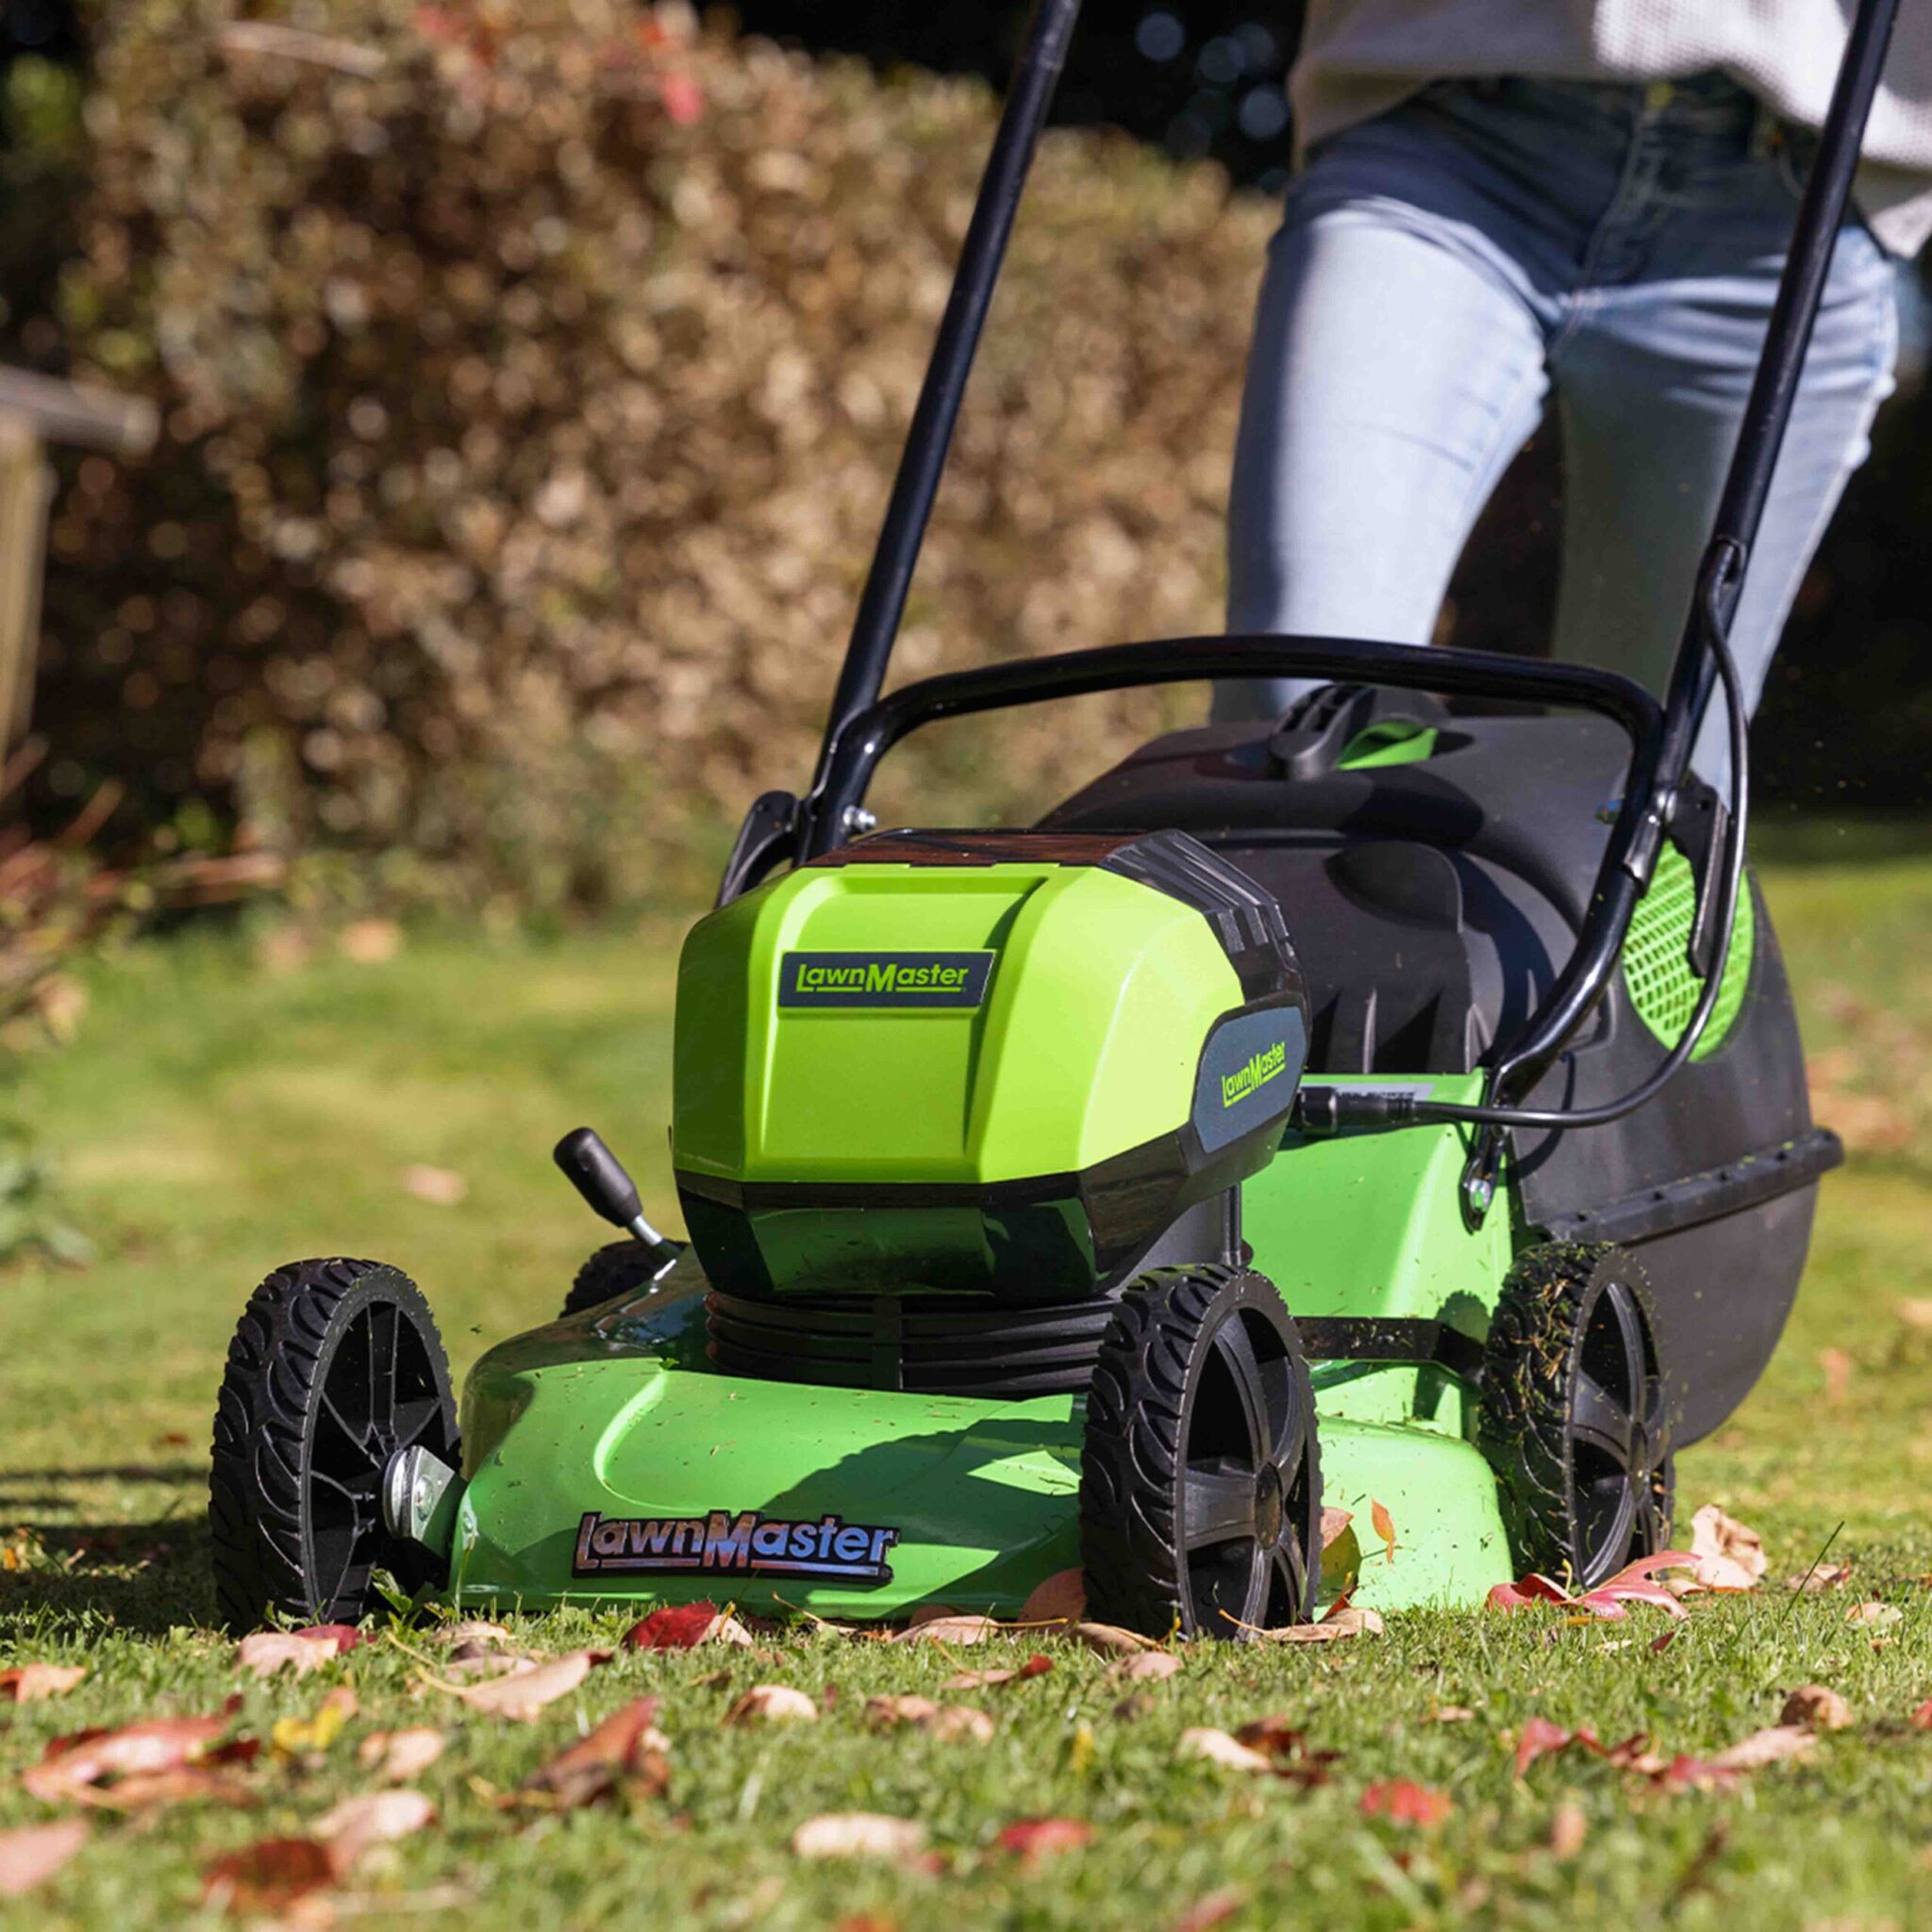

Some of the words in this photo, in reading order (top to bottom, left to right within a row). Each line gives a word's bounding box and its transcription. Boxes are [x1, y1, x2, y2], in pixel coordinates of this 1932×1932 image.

[795, 963, 970, 992] LawnMaster
[1221, 1041, 1286, 1108] LawnMaster
[576, 1511, 894, 1570] LawnMaster
